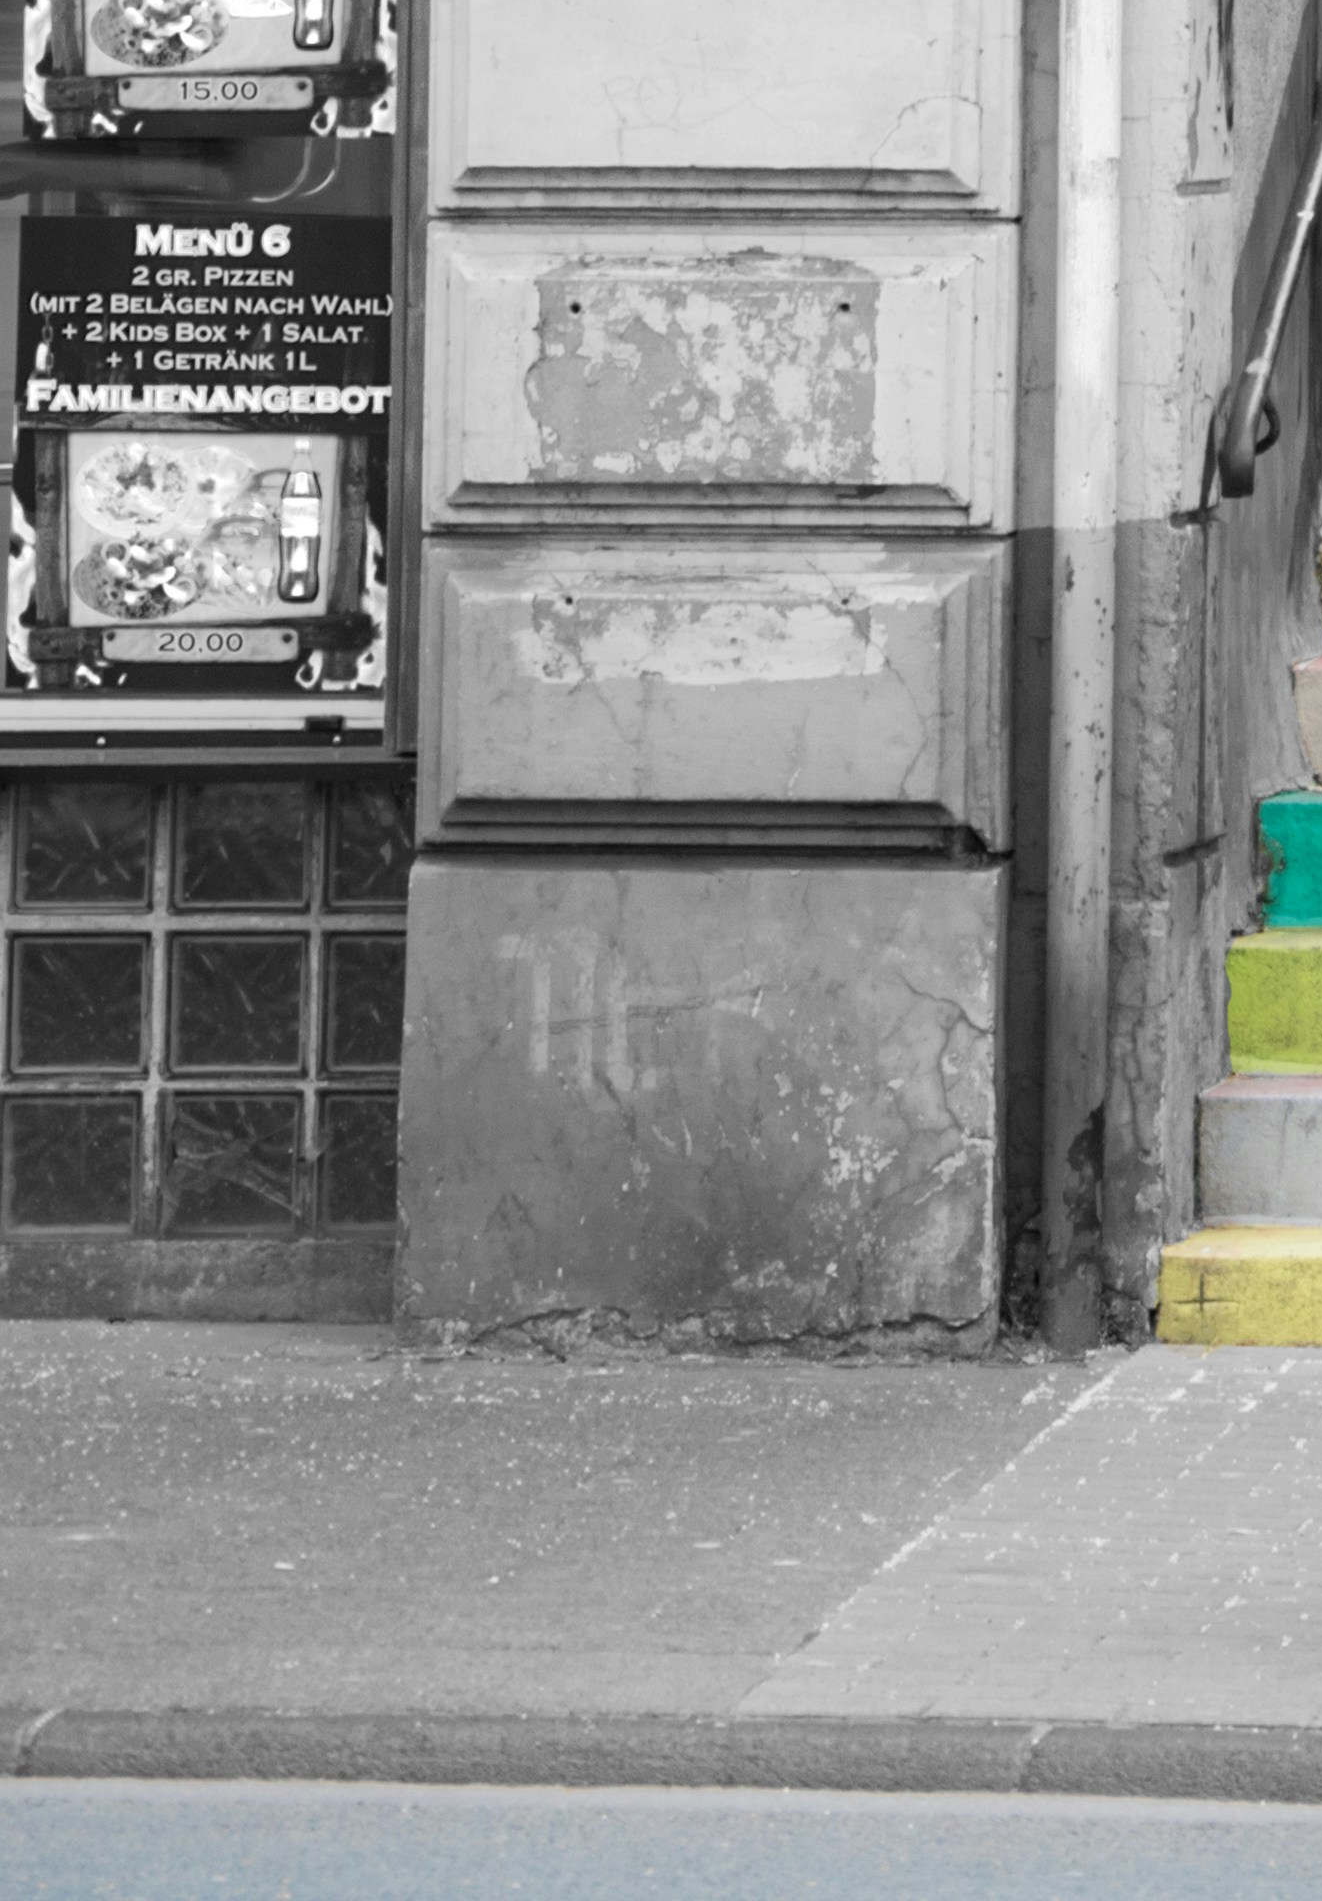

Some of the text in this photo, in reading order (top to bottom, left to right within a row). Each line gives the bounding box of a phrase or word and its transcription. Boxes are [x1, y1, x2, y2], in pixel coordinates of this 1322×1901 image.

[178, 81, 259, 101] 15.00
[262, 221, 290, 256] 6
[133, 266, 149, 287] 2
[87, 291, 102, 317] 2
[235, 291, 306, 317] NACH
[63, 322, 77, 344] +
[85, 322, 103, 344] 2
[235, 322, 250, 344] +
[262, 322, 274, 344] 1
[107, 349, 122, 372] +
[133, 349, 144, 372] 1
[286, 349, 315, 372] 1L
[158, 632, 244, 653] 20.00
